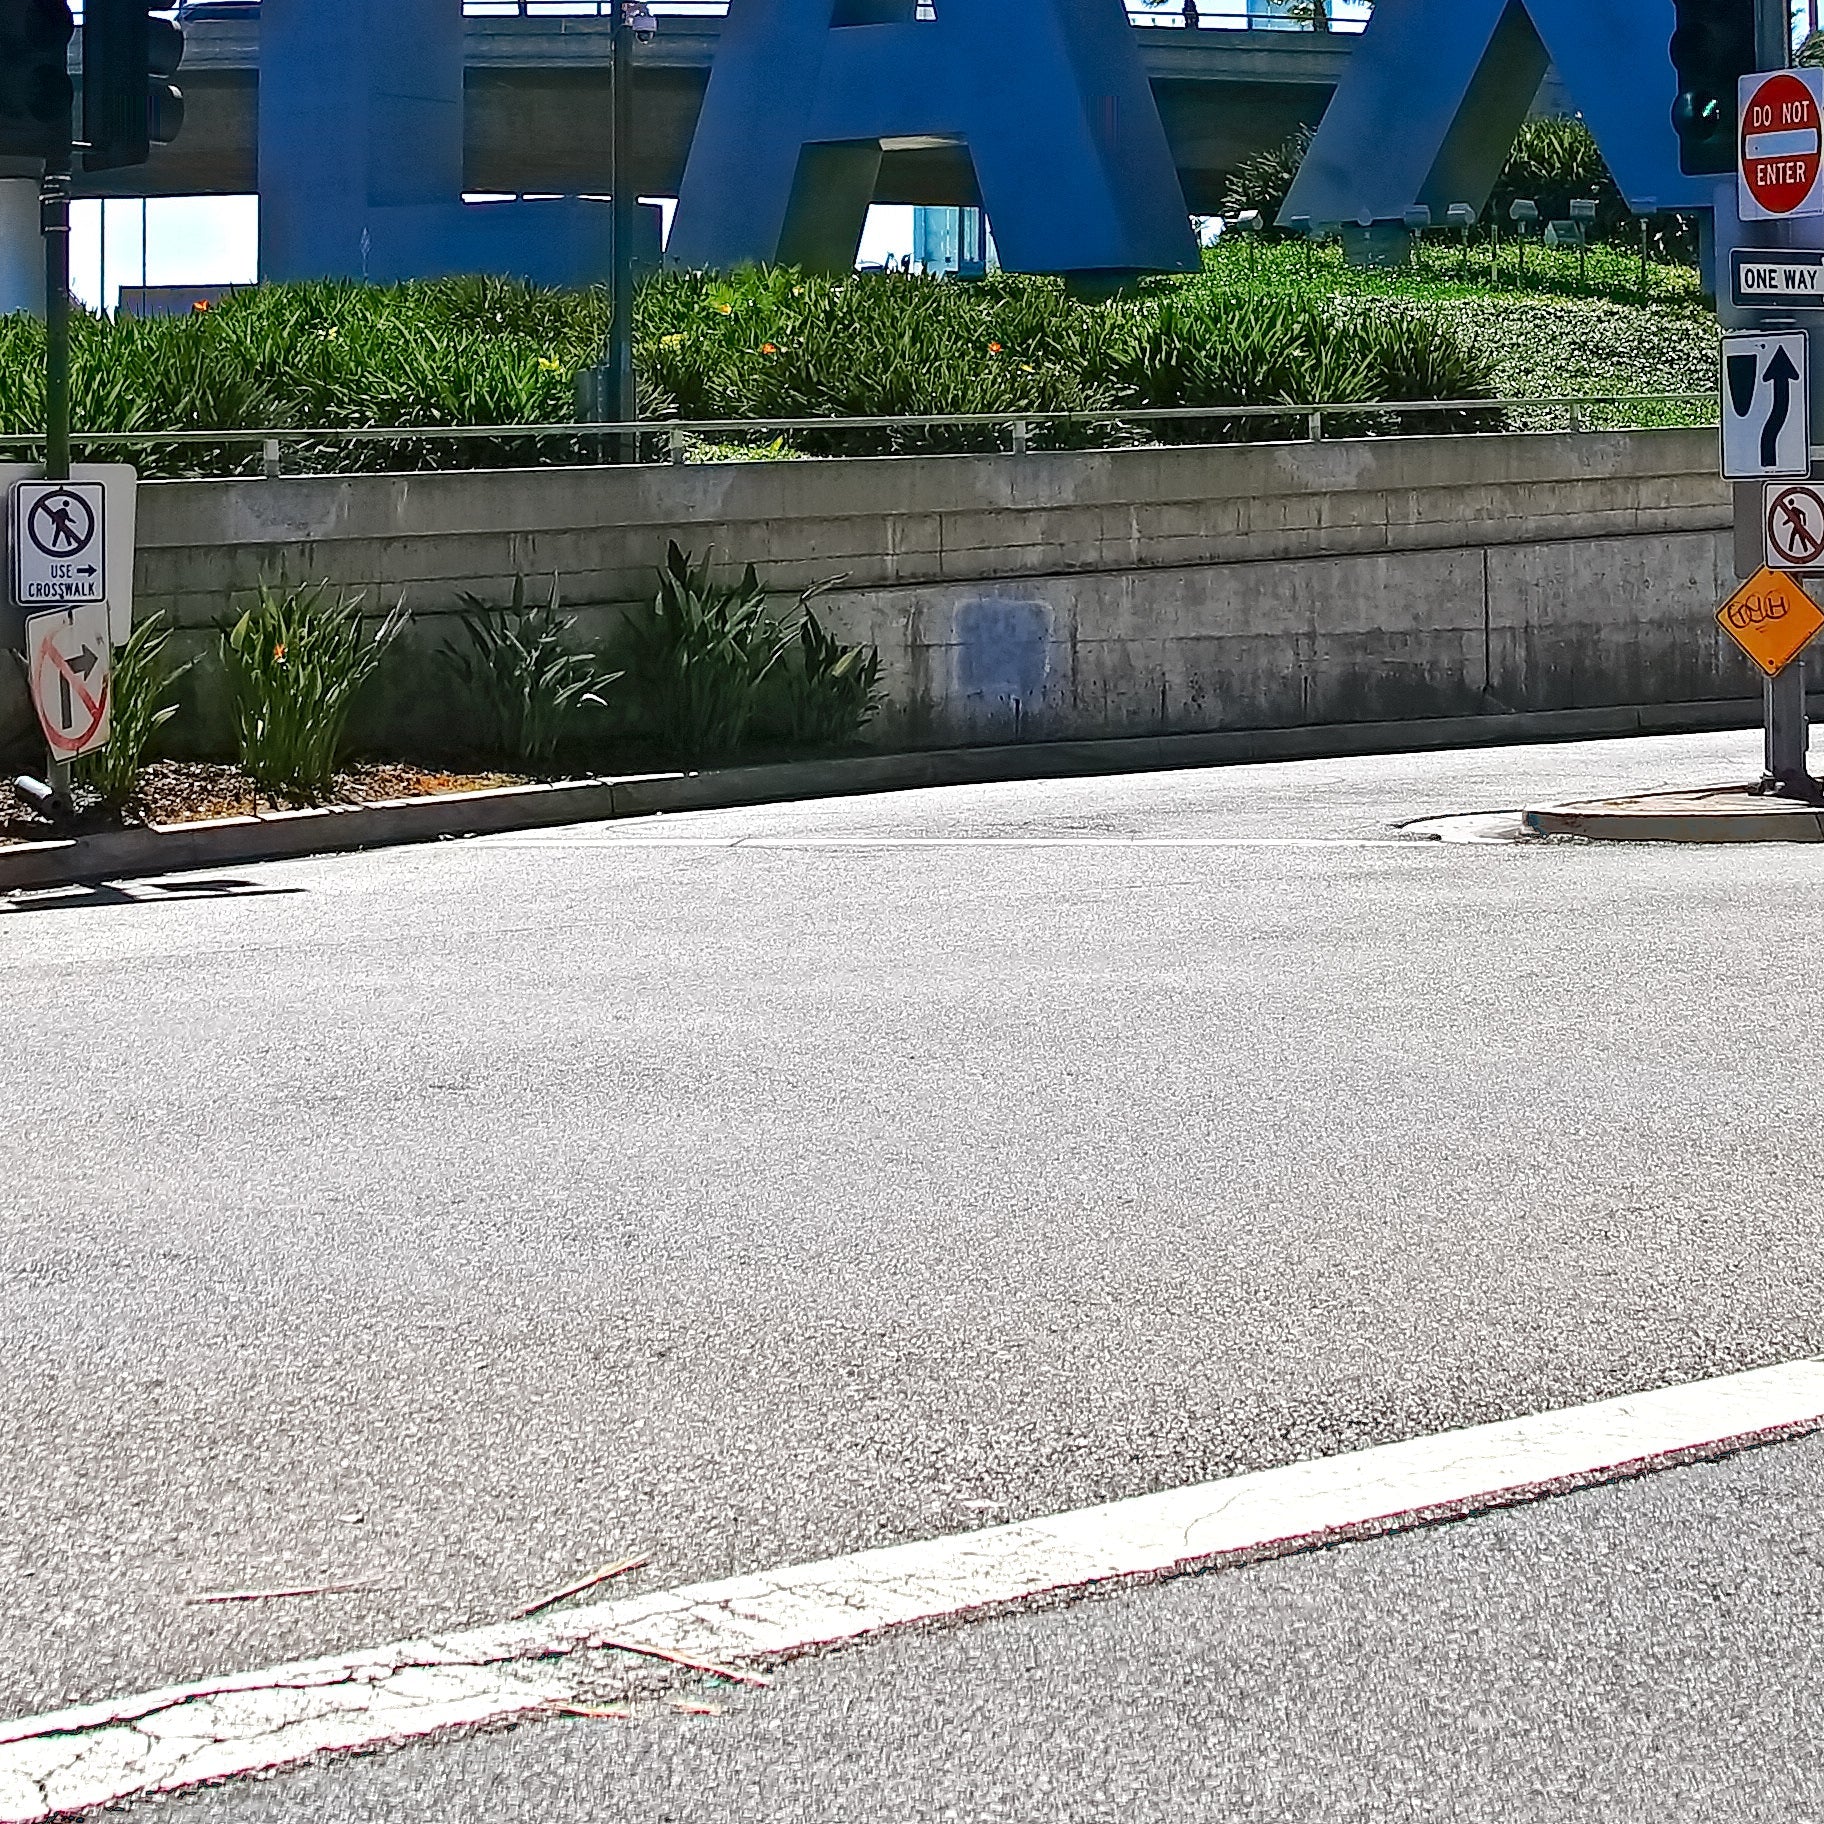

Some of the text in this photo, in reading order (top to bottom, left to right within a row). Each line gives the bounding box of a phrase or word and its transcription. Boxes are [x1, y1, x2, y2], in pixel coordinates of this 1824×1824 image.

[1753, 101, 1810, 127] DO NOT
[1756, 161, 1806, 186] ENTER
[1744, 268, 1818, 290] ONE WAY
[50, 564, 73, 579] USE
[28, 582, 96, 597] CROSSWALK
